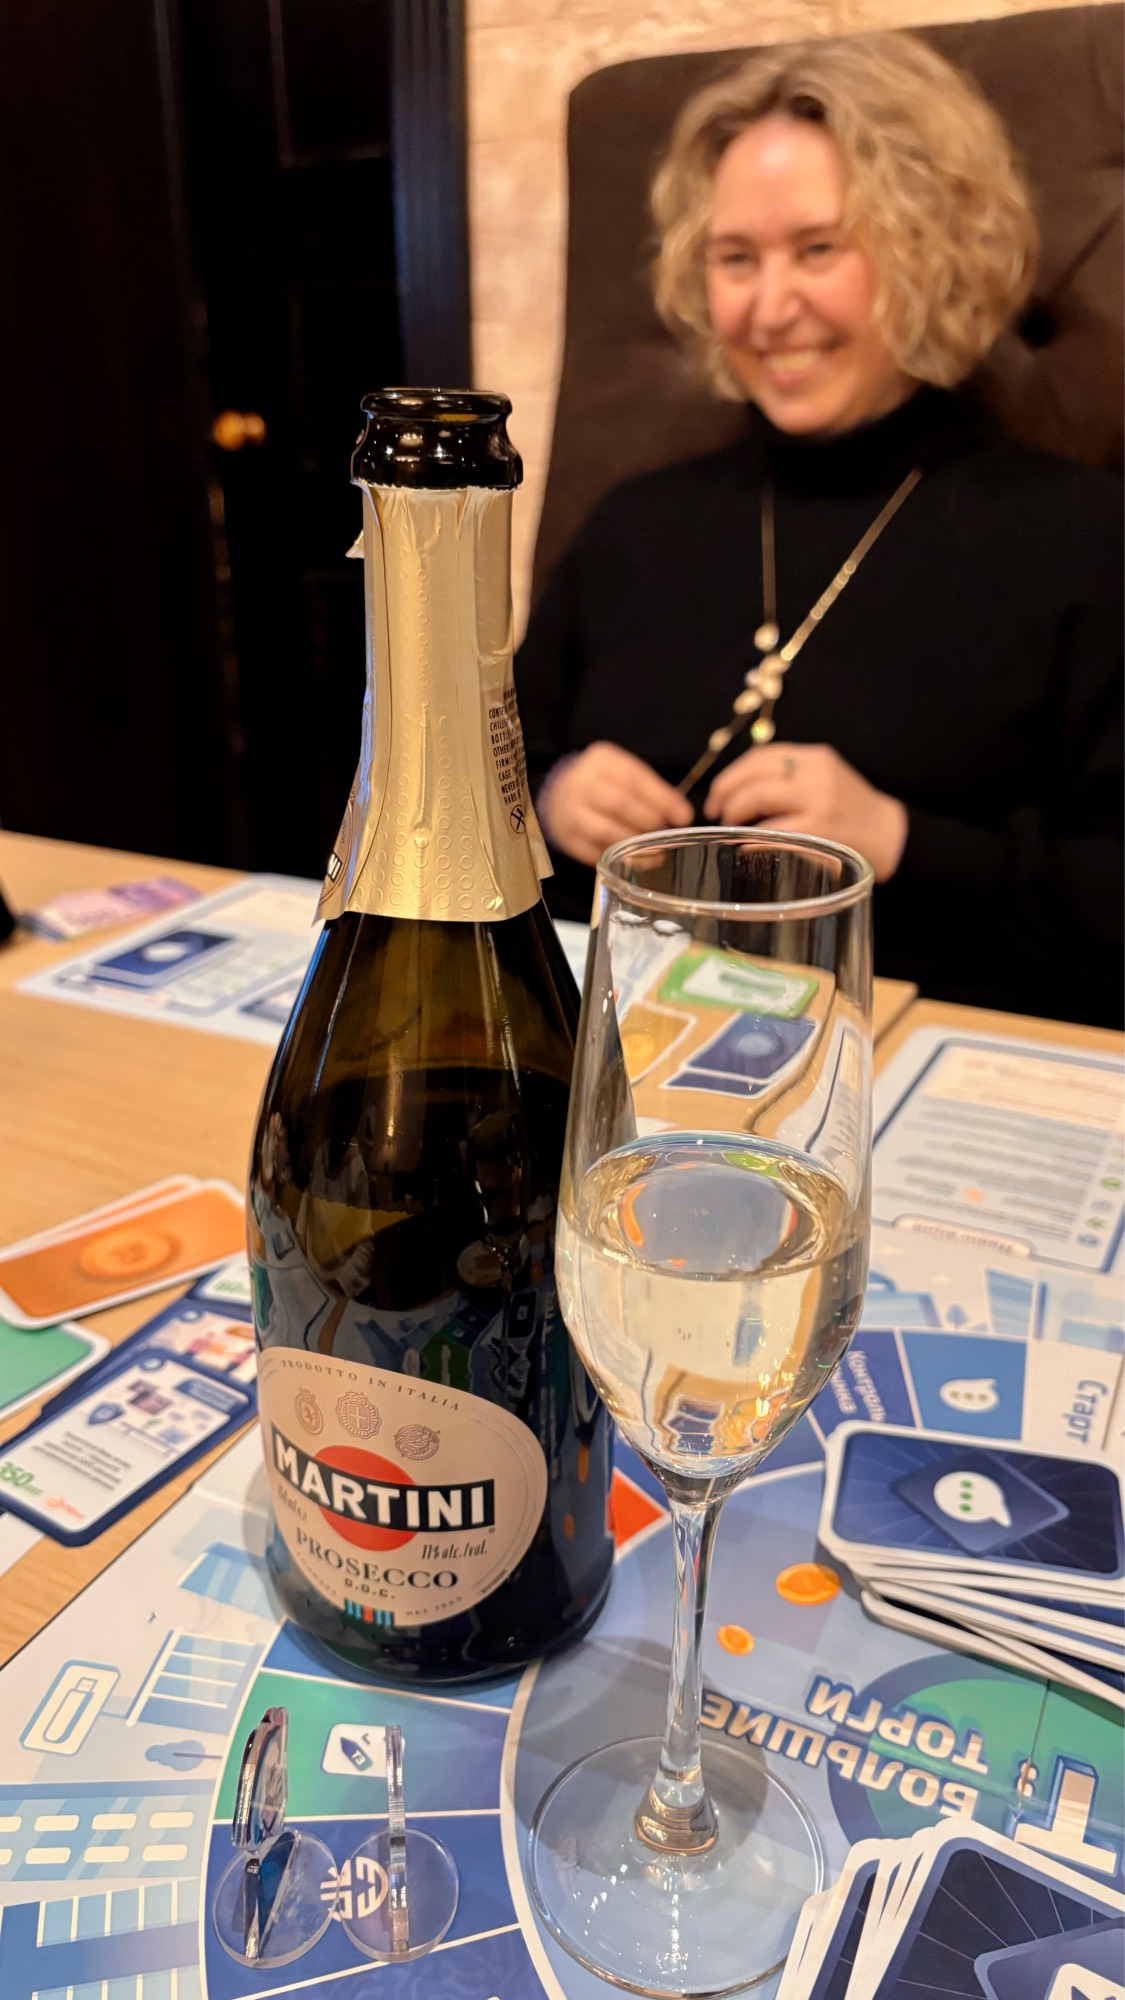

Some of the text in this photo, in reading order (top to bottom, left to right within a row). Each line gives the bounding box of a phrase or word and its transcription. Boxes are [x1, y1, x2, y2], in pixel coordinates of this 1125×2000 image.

[498, 769, 512, 782] CAGE
[501, 780, 516, 794] NEVER
[281, 1359, 459, 1411] PRODOTTO IN ITALIA
[831, 1366, 858, 1414] ынка
[847, 1351, 887, 1422] Контроль
[1062, 1379, 1109, 1444] Старт
[275, 1433, 484, 1528] MARTINI
[296, 1527, 459, 1589] PROSECCO
[344, 1577, 396, 1600] D.O.C.
[700, 1693, 978, 1820] БОЛЬШИЕ
[807, 1680, 988, 1776] ТОРГИ
